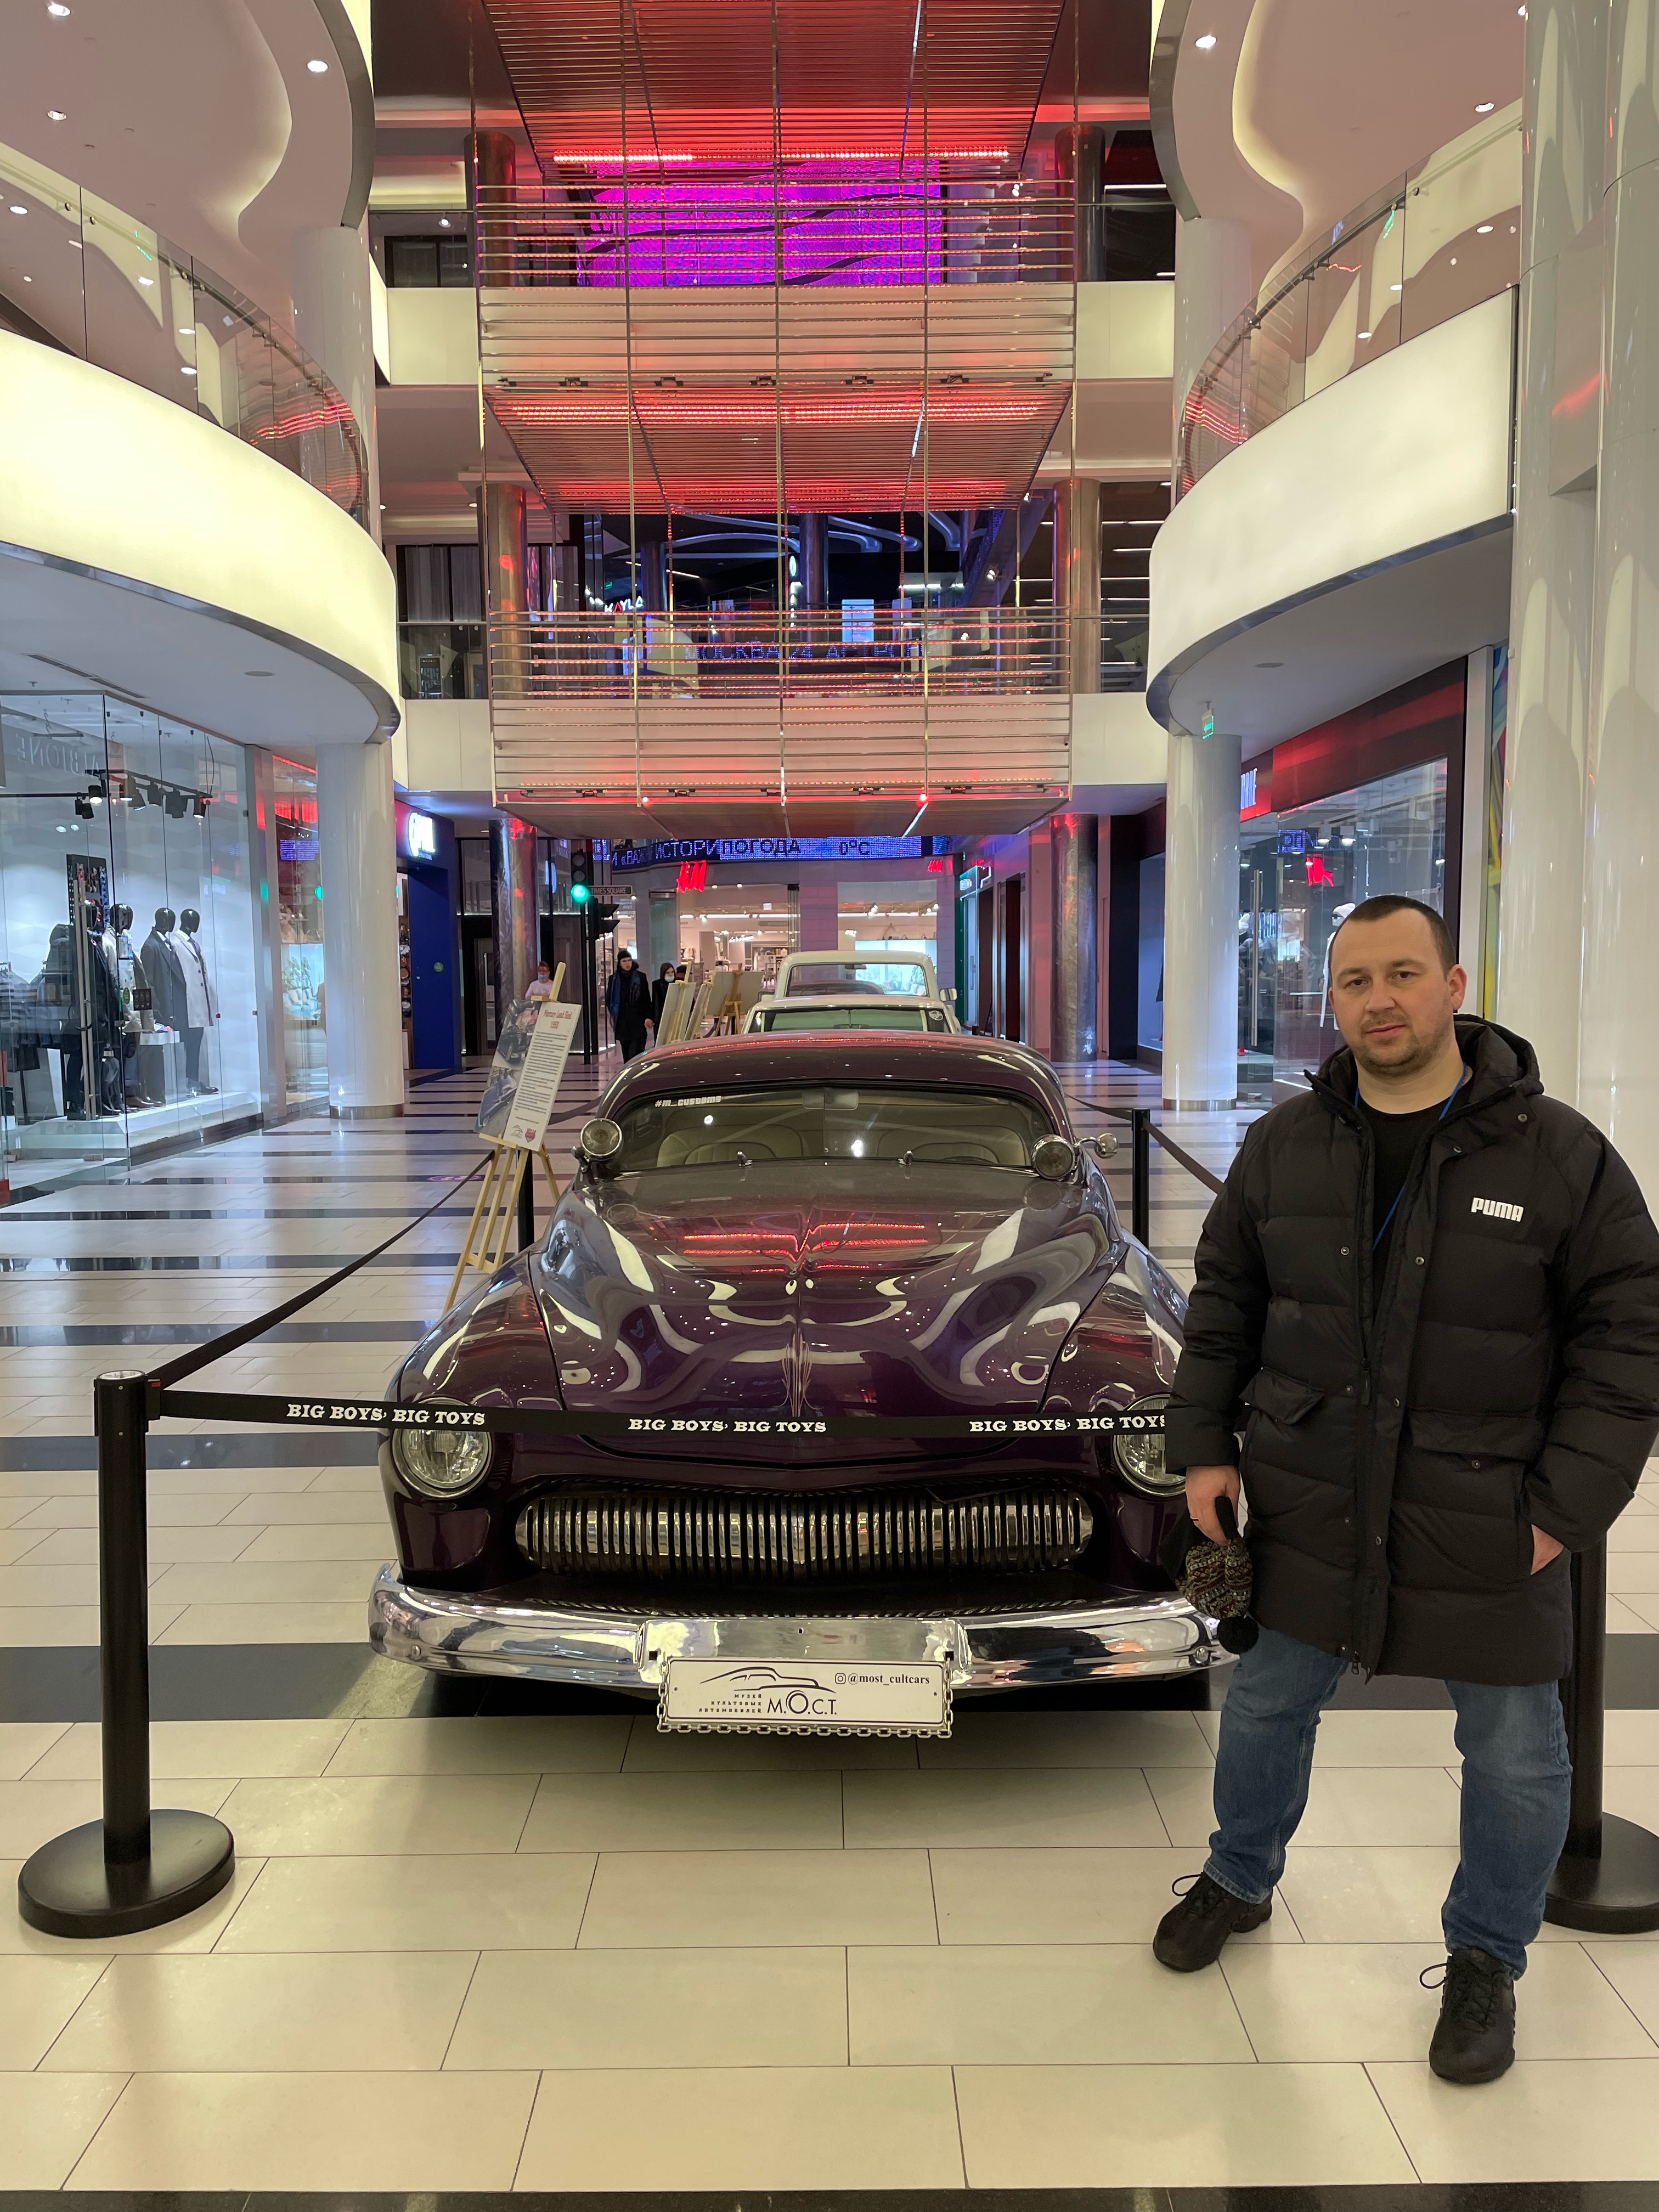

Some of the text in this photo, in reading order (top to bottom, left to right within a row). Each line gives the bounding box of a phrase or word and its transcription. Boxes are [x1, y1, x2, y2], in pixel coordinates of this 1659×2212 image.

[722, 839, 801, 856] ПОГОДА
[1471, 1197, 1524, 1222] PUMA
[286, 1404, 325, 1418] BIG
[392, 1409, 430, 1423] BIG
[435, 1412, 485, 1425] TOYS
[628, 1419, 667, 1431] BIG
[733, 1421, 771, 1432] BIG
[775, 1421, 827, 1433] TOYS
[969, 1420, 1008, 1432] BIG
[1076, 1417, 1115, 1430] BIG
[848, 1673, 930, 1686] @most_cultcars
